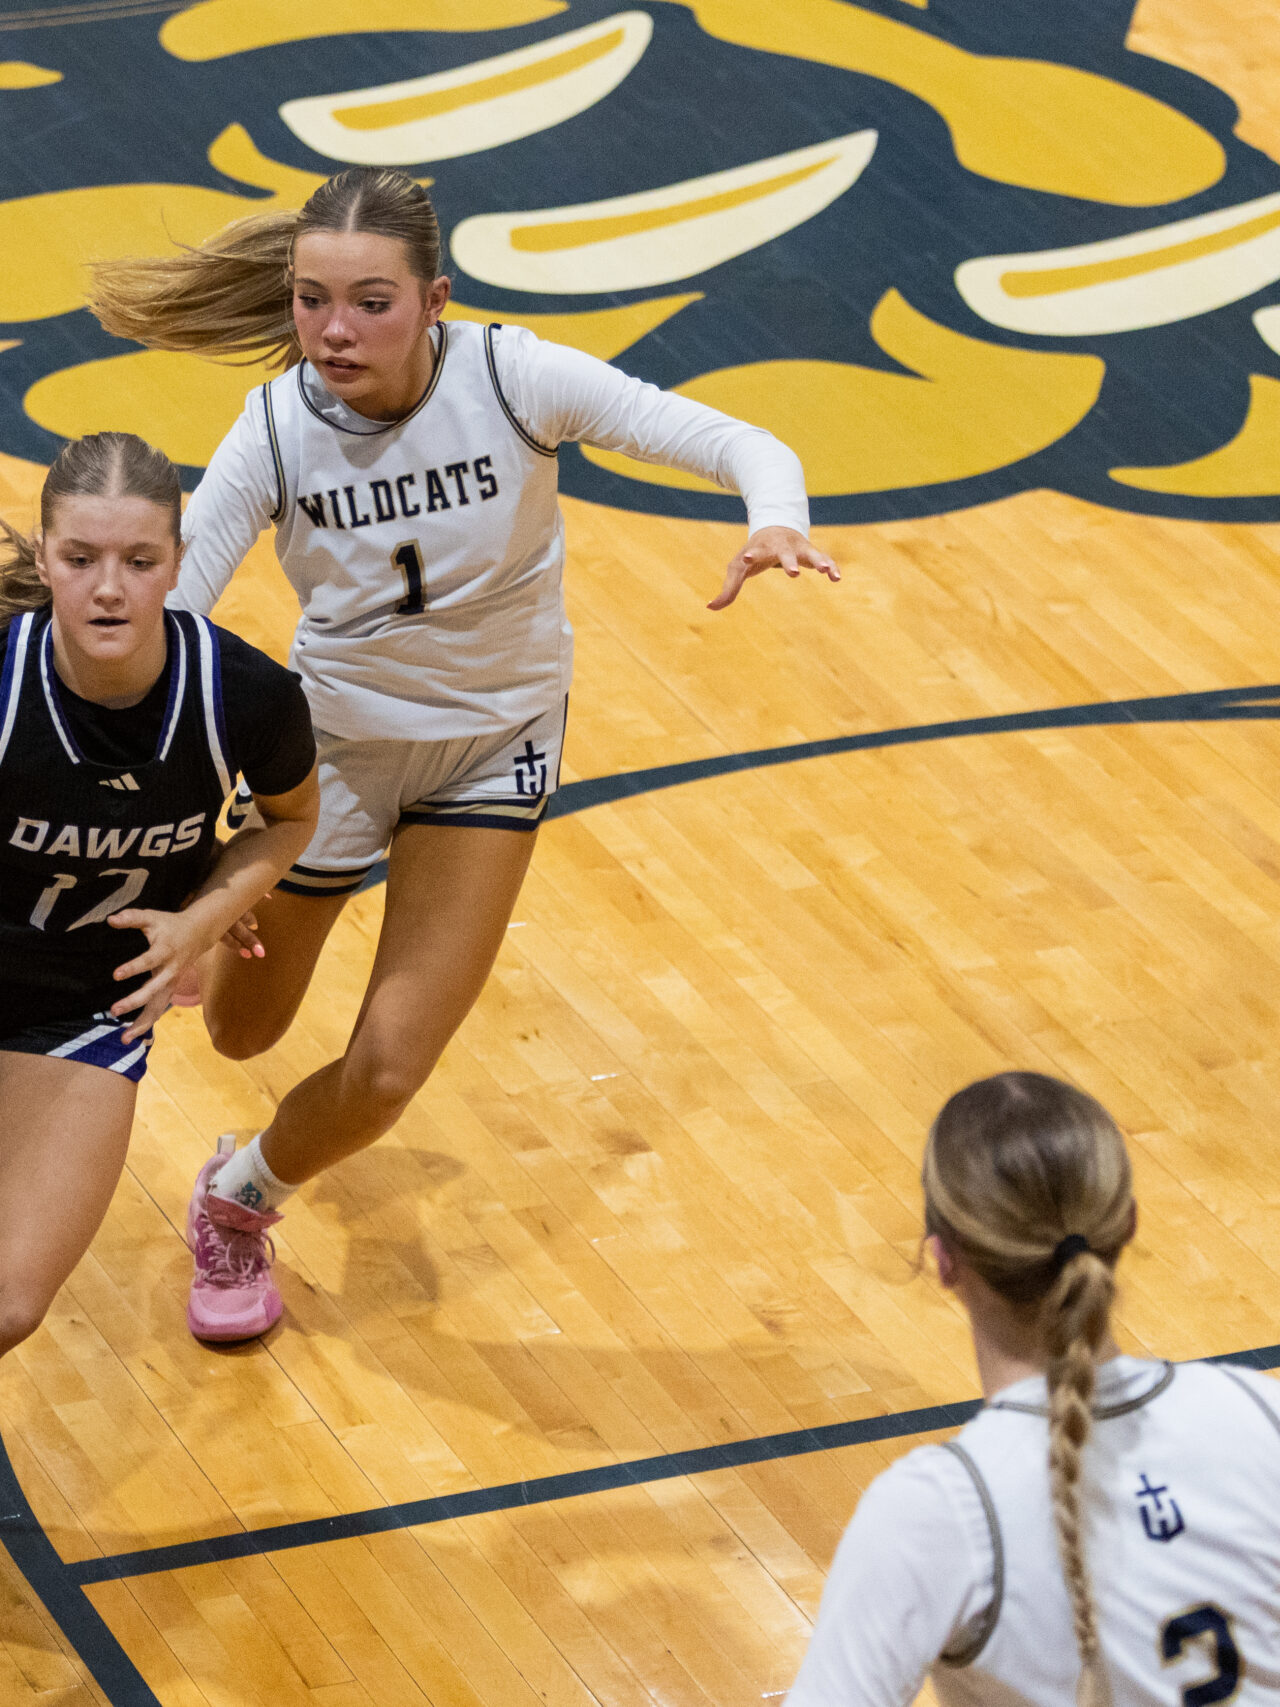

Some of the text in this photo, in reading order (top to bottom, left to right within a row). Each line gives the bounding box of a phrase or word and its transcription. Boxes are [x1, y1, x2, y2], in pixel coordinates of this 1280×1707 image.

[297, 455, 499, 529] WILDCATS
[390, 538, 427, 616] 1
[8, 812, 206, 859] DAWGS
